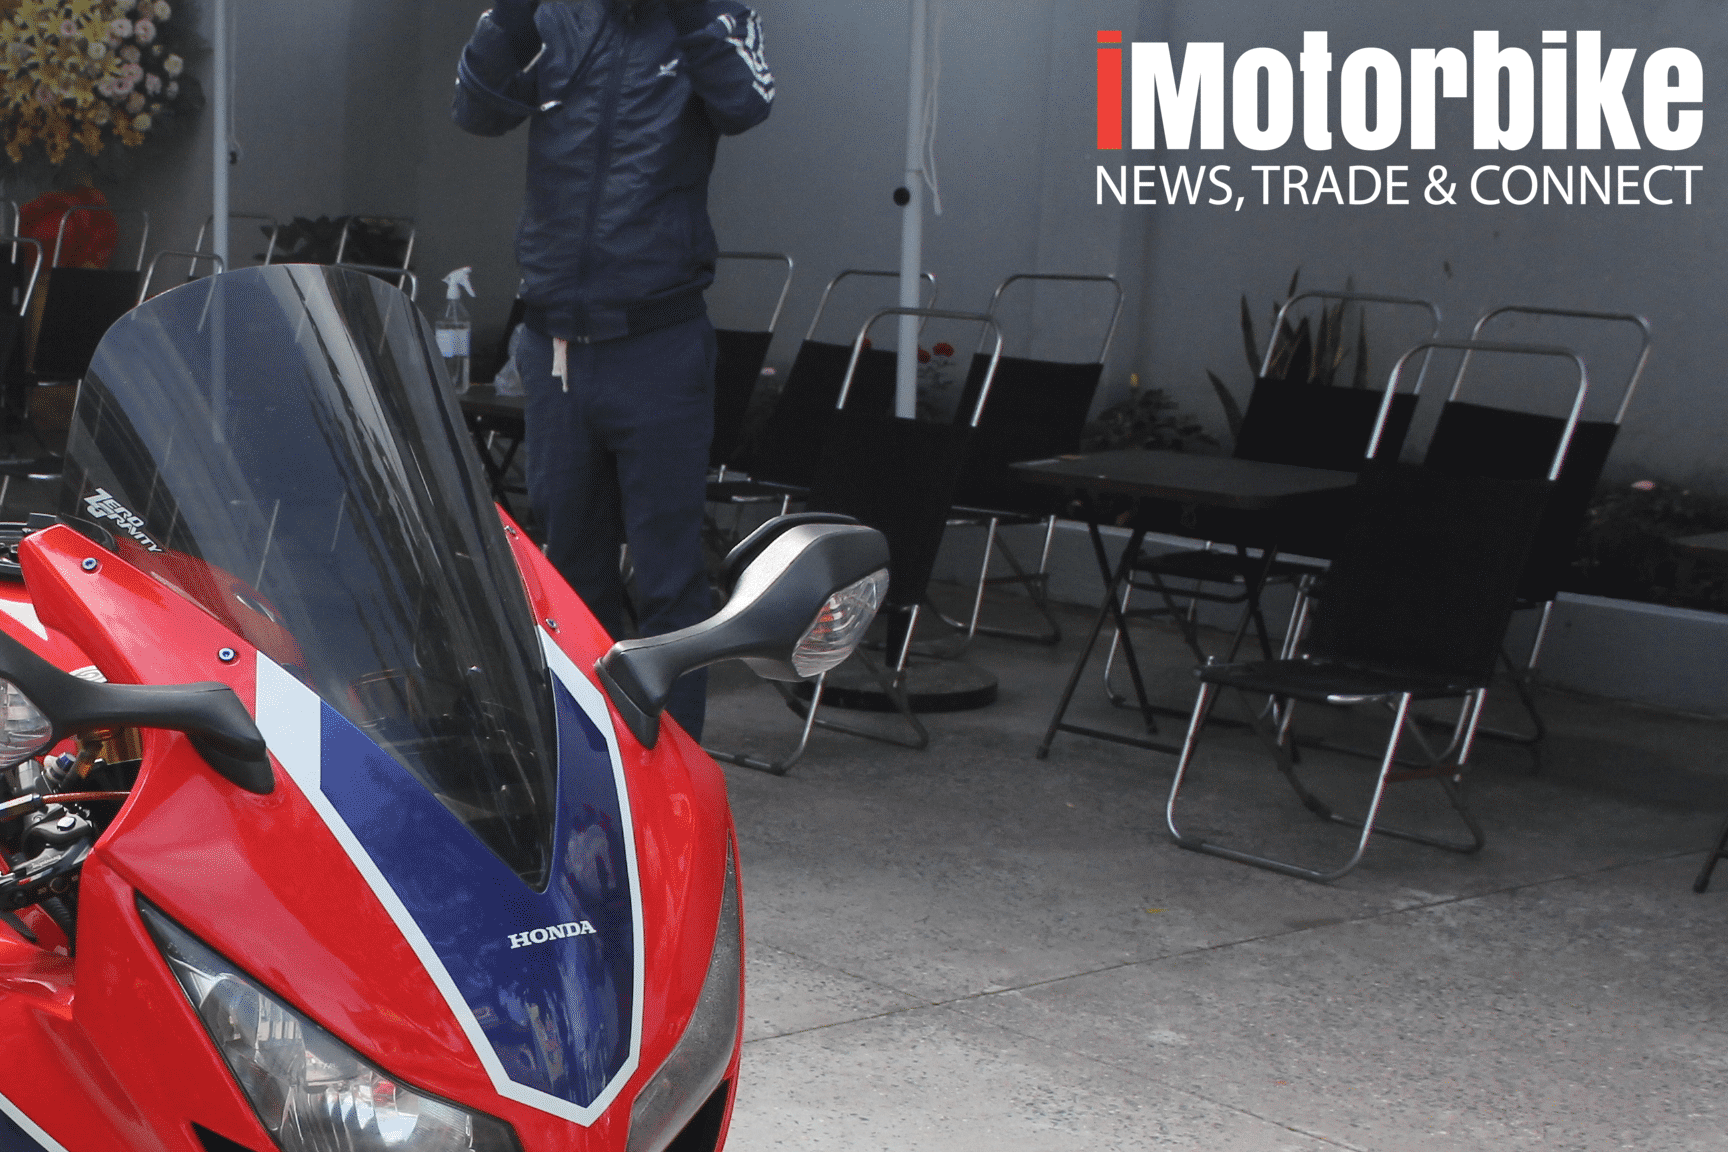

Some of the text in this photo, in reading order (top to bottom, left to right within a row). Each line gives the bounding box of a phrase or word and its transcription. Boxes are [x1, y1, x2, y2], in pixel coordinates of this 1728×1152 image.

[83, 487, 145, 528] ZERO
[86, 503, 163, 552] GRAVITY
[507, 920, 597, 949] HONDA
